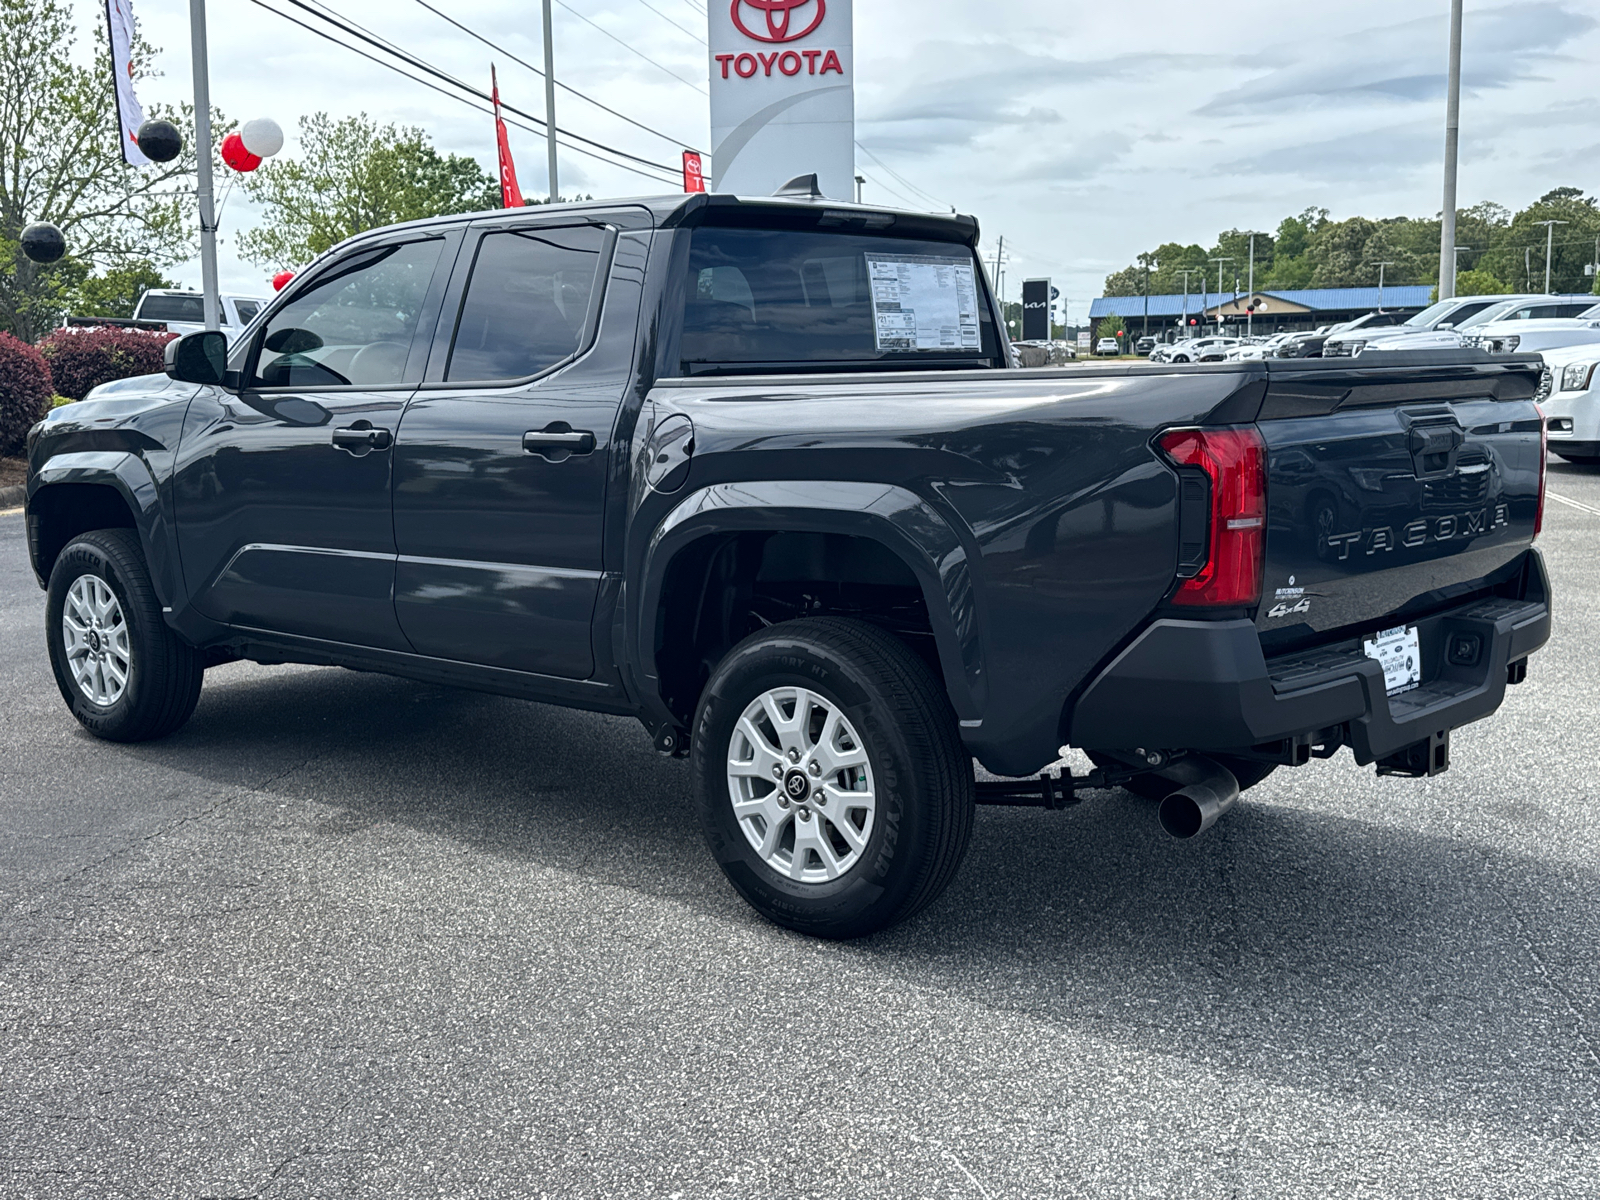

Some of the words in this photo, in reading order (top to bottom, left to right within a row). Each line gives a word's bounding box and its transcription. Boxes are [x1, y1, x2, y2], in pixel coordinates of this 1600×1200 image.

[715, 50, 843, 79] TOYOTA
[1328, 503, 1510, 560] TACOMA
[1267, 597, 1311, 618] 4x4
[811, 664, 829, 679] HT
